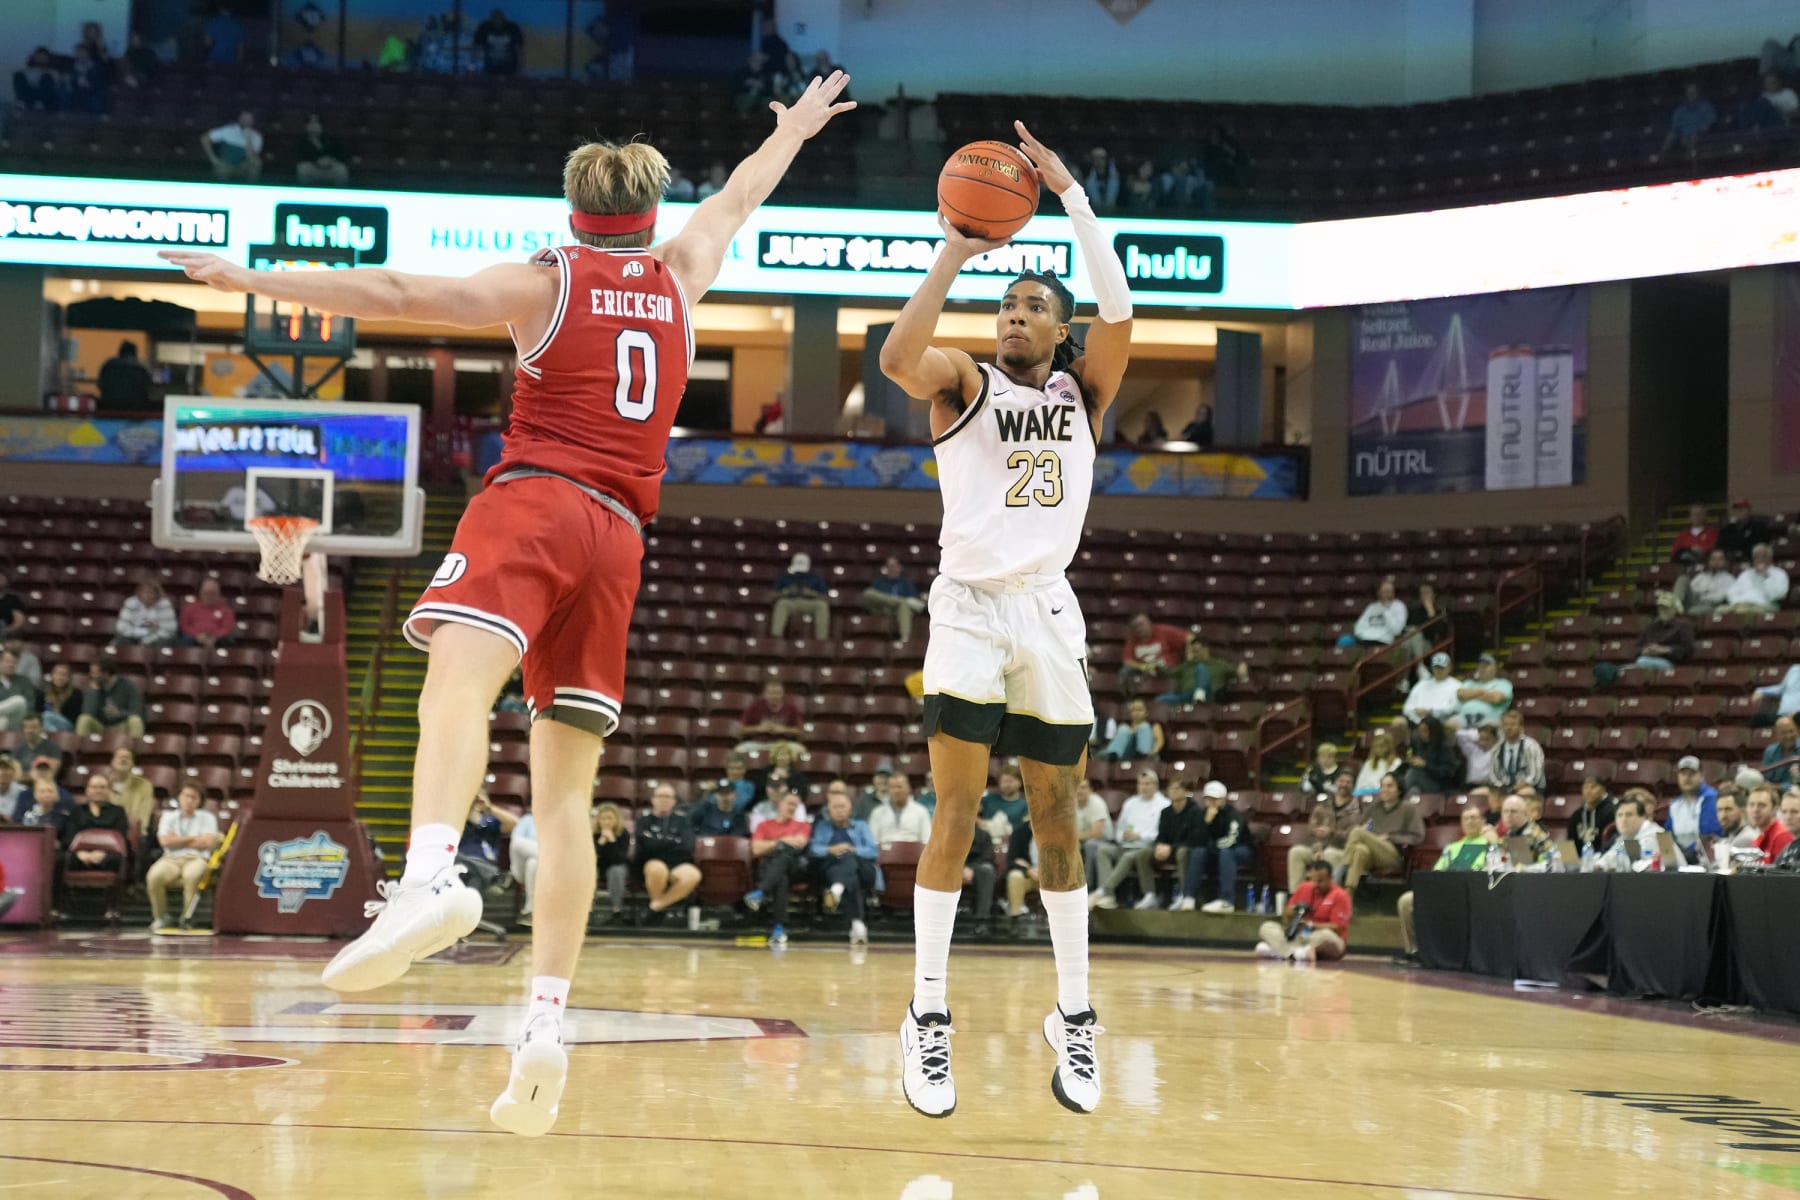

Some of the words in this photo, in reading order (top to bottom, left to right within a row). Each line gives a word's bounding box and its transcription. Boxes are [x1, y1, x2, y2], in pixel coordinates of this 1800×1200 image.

[285, 213, 376, 252] hulu
[430, 228, 514, 252] HULU
[762, 234, 846, 267] JUST
[1125, 244, 1212, 281] hulu
[590, 288, 673, 324] ERICKSON
[613, 327, 658, 424] 0
[994, 405, 1076, 442] WAKE
[1005, 449, 1064, 507] 23
